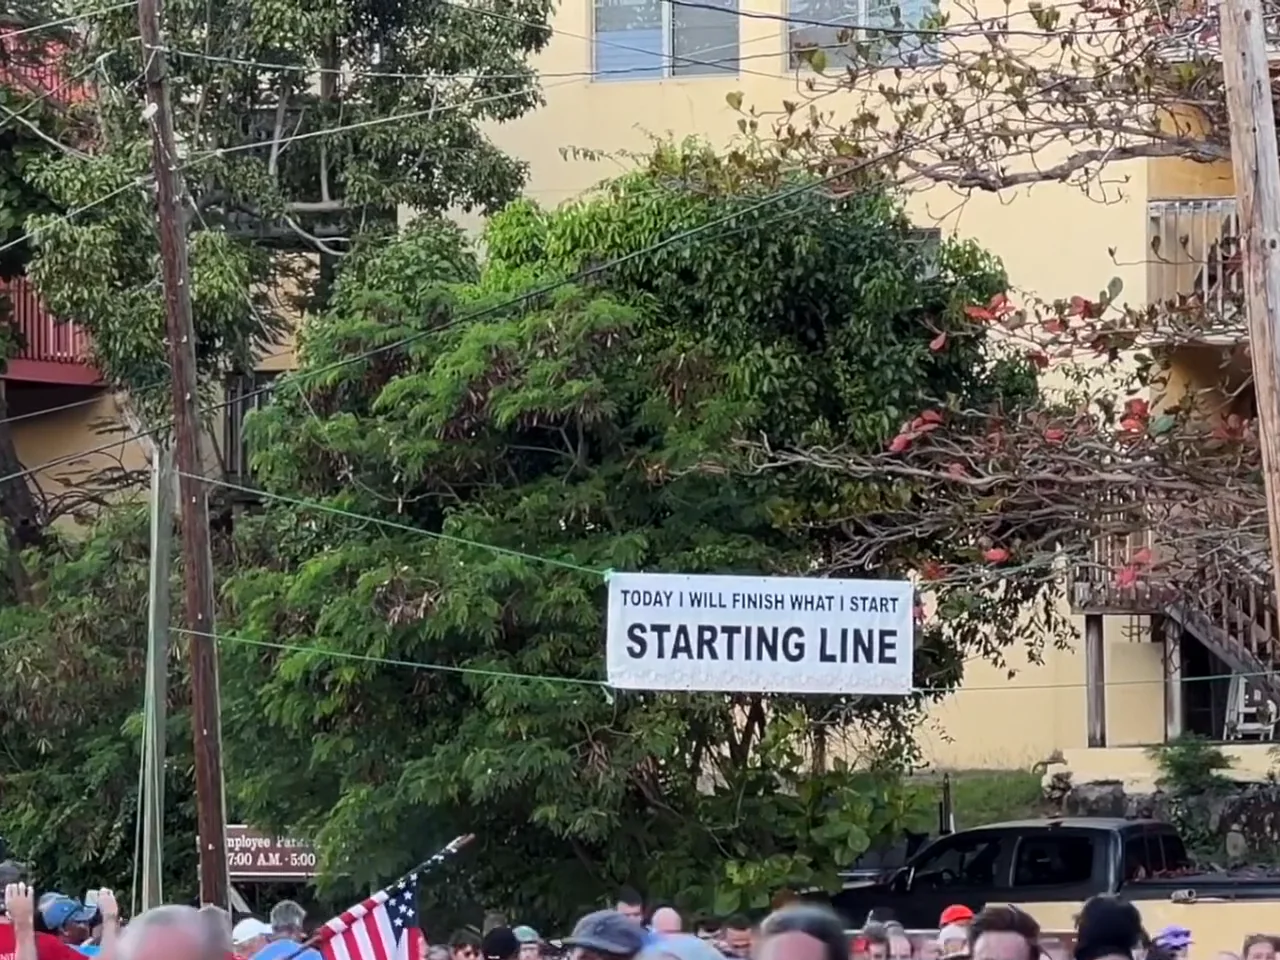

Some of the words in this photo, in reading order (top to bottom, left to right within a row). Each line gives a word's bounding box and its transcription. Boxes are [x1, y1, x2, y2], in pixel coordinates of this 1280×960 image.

[621, 589, 673, 607] TODAY
[679, 591, 684, 607] I
[688, 592, 727, 609] WILL
[732, 592, 785, 611] FINISH
[790, 594, 835, 612] WHAT
[840, 595, 845, 612] I
[849, 596, 899, 613] START
[626, 622, 805, 663] STARTING
[819, 628, 898, 664] LINE
[227, 834, 271, 851] mployee
[228, 853, 252, 866] 7:00
[290, 853, 316, 867] 5:00
